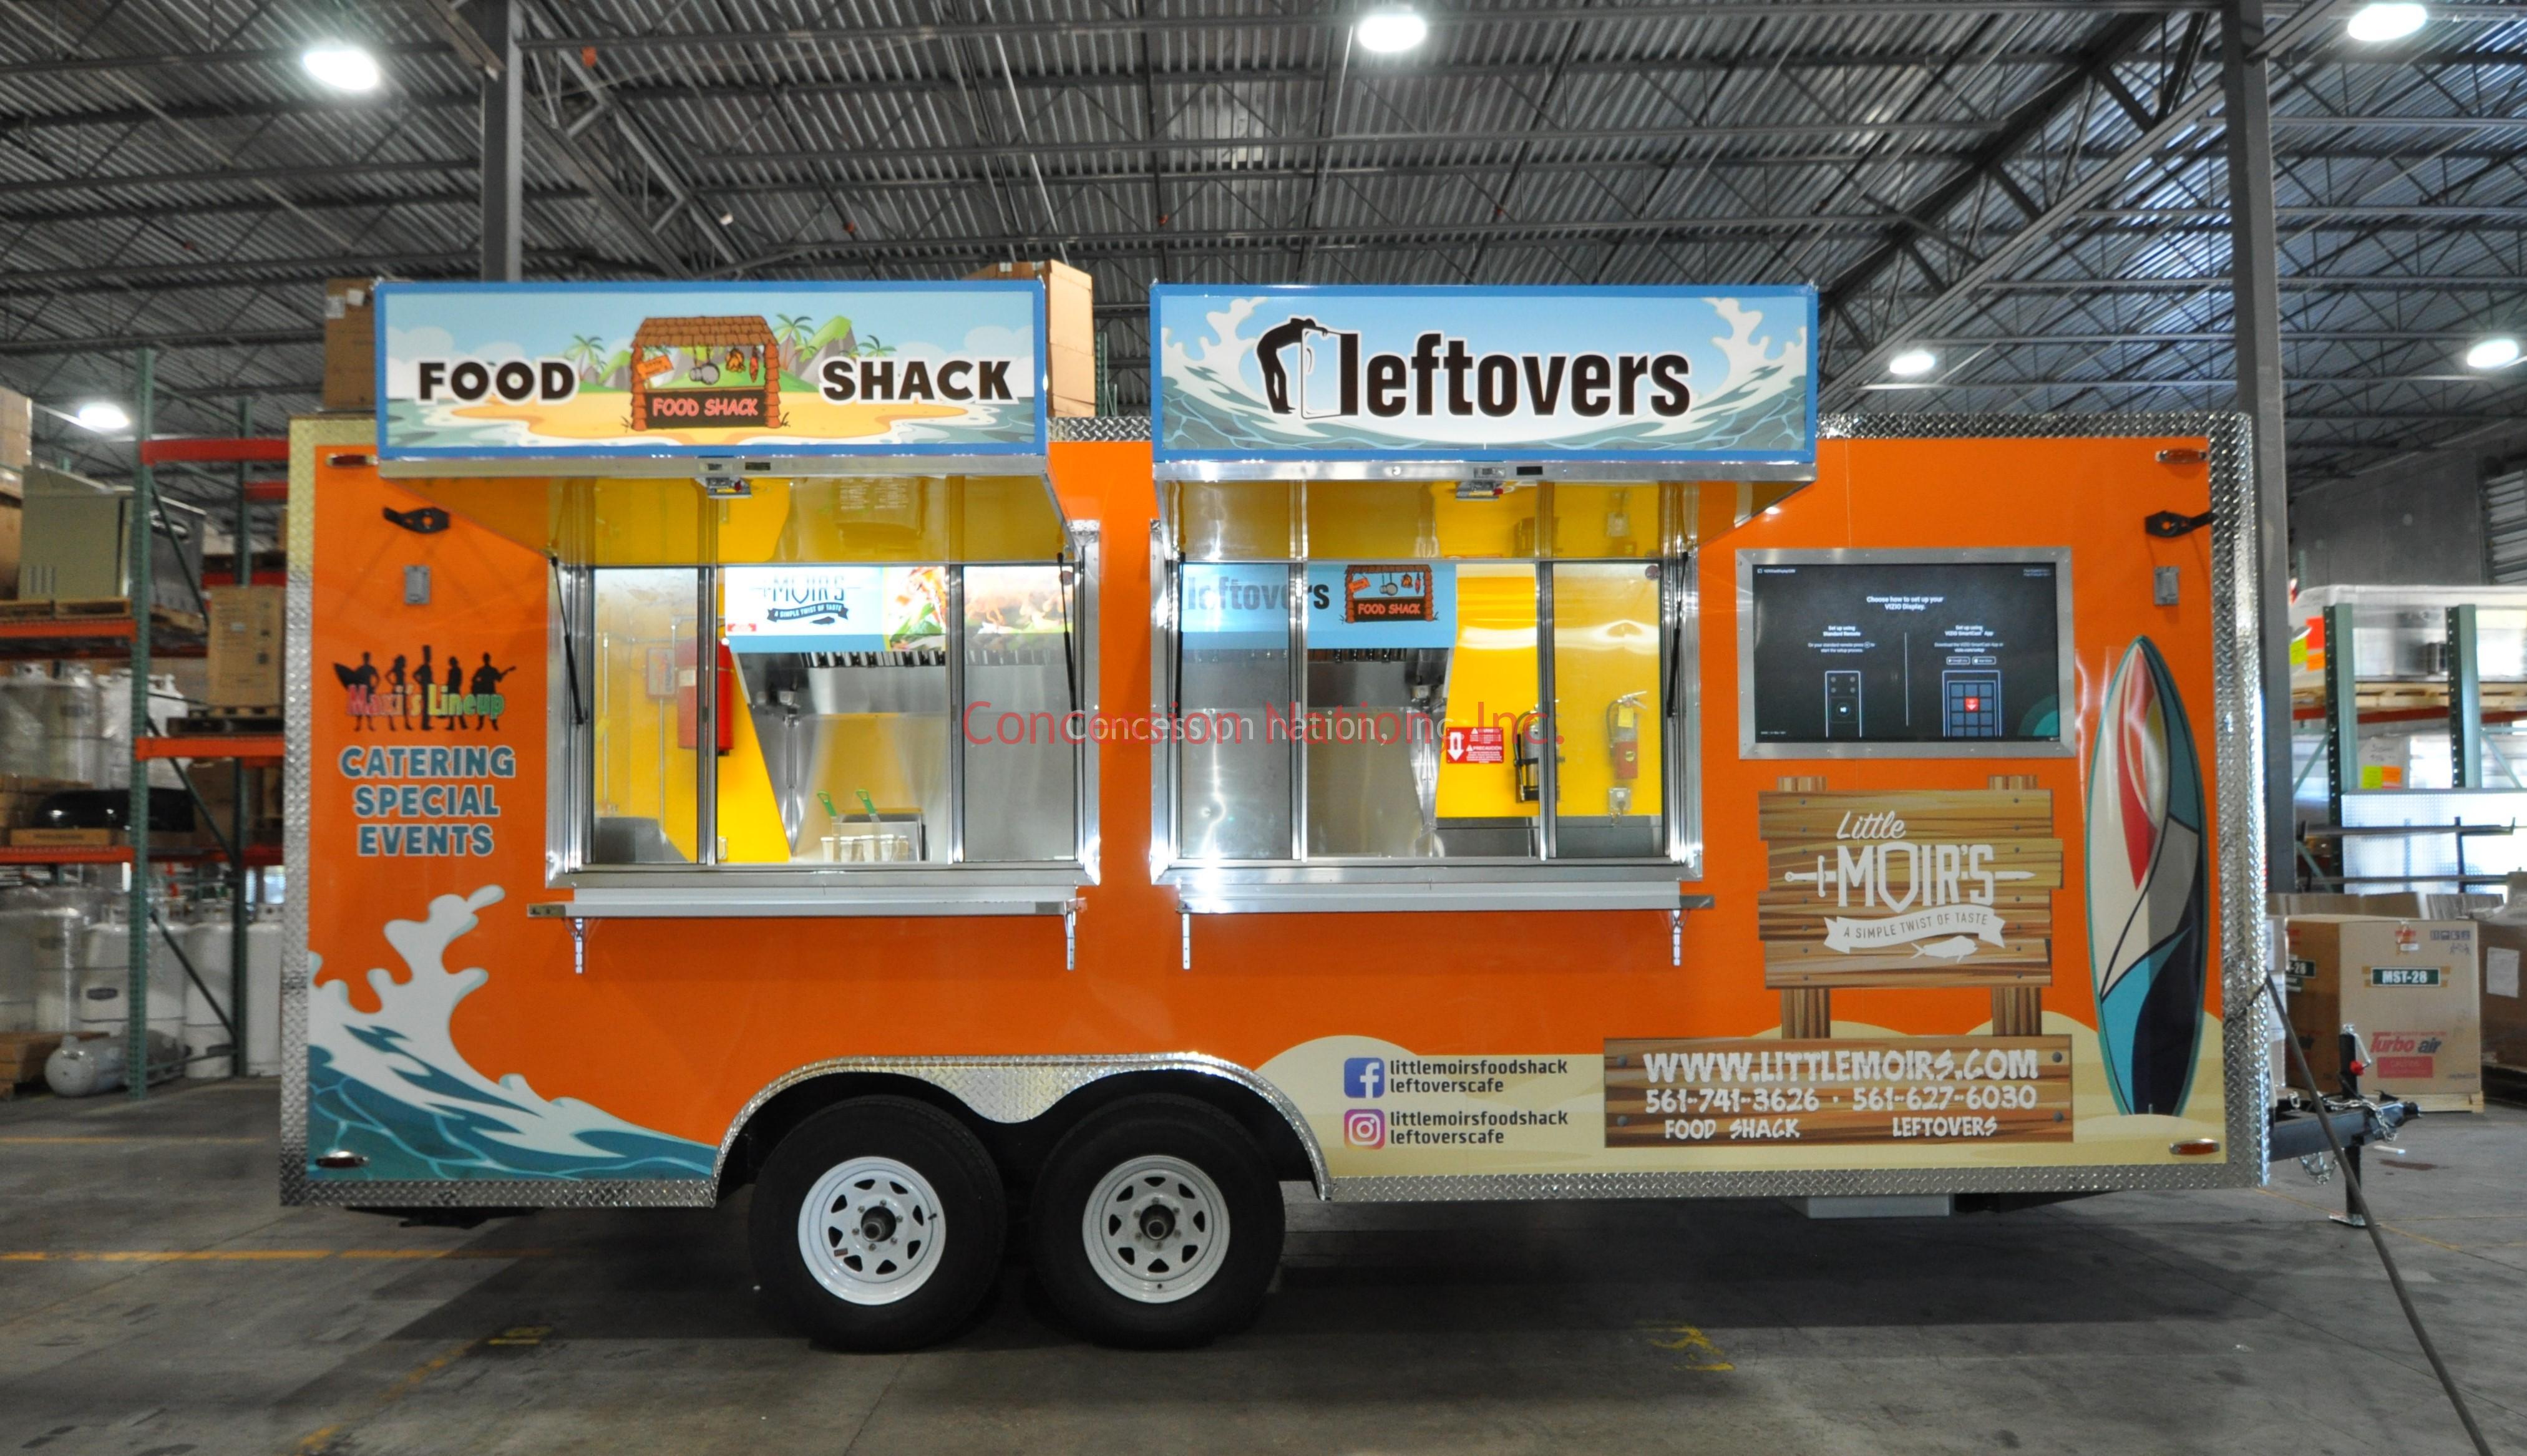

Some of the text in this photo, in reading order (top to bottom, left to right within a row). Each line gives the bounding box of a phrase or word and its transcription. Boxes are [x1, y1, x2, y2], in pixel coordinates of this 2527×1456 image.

[419, 361, 1013, 400] FOOD SHACK
[1340, 331, 1690, 417] leftovers
[652, 397, 759, 417] FOOD SHACK
[1358, 603, 1421, 614] FOOD SHACK
[427, 683, 505, 720] Lineup
[340, 746, 516, 777] CATERING
[354, 785, 500, 817] SPECIAL
[1836, 810, 1906, 840] Little
[359, 825, 494, 856] EVENTS
[1836, 841, 1994, 913] MOIR'S
[1844, 911, 1989, 939] A SIMPLE TWIST OF TASTE
[2382, 969, 2428, 984] MST-28
[2369, 1031, 2442, 1054] Turbo air
[1390, 1059, 1569, 1075] littlemoirsfoodshack
[1642, 1048, 2038, 1084] WWW.LITTLEMOIRS.COM
[1390, 1077, 1504, 1093] leftoverscafe
[1645, 1085, 2038, 1114] 561-741-3626 561-627-6030
[1390, 1110, 1569, 1127] littlemoirsfoodshack
[1664, 1119, 1801, 1140] FOOD SHACK
[1892, 1115, 1998, 1137] LEFTOVERS
[1390, 1128, 1505, 1145] leftoverscafe
